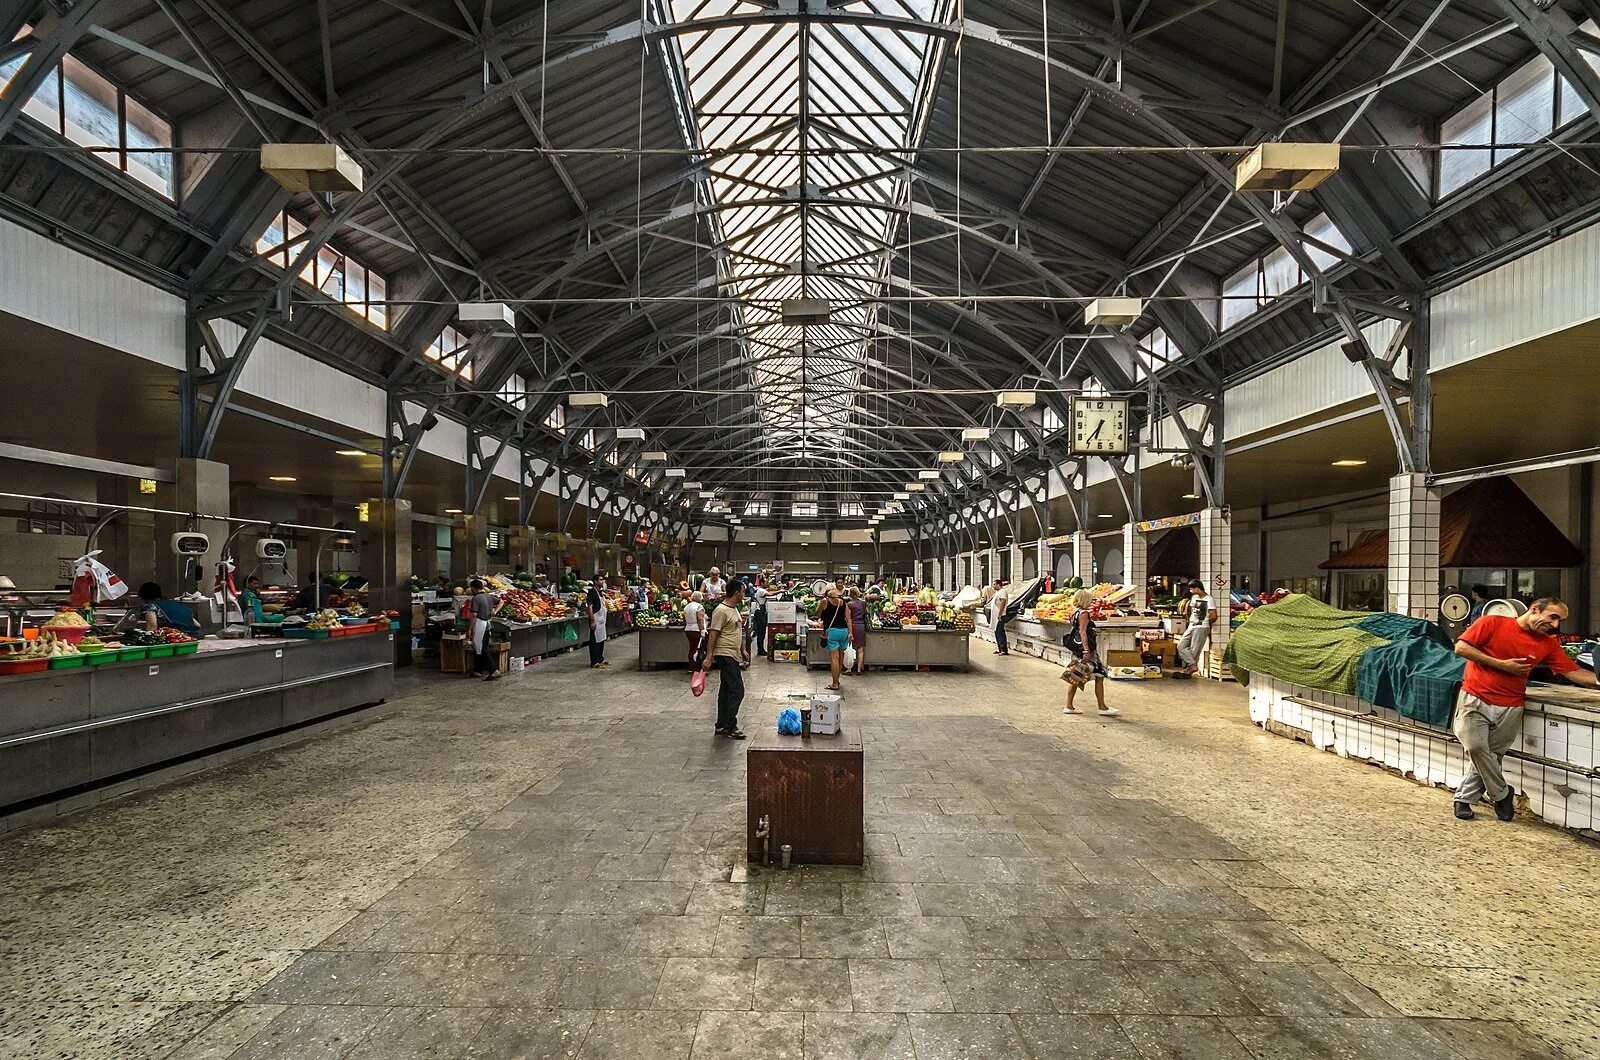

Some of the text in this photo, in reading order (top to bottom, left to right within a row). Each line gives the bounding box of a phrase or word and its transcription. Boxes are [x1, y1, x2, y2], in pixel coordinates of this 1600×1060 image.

[1076, 410, 1083, 418] 10
[1117, 410, 1123, 418] 2
[1077, 422, 1083, 430] 9
[1117, 422, 1123, 430] 3
[1077, 433, 1083, 441] 8
[1117, 433, 1123, 441] 4
[1097, 442, 1103, 450] 6
[1108, 442, 1114, 450] 5
